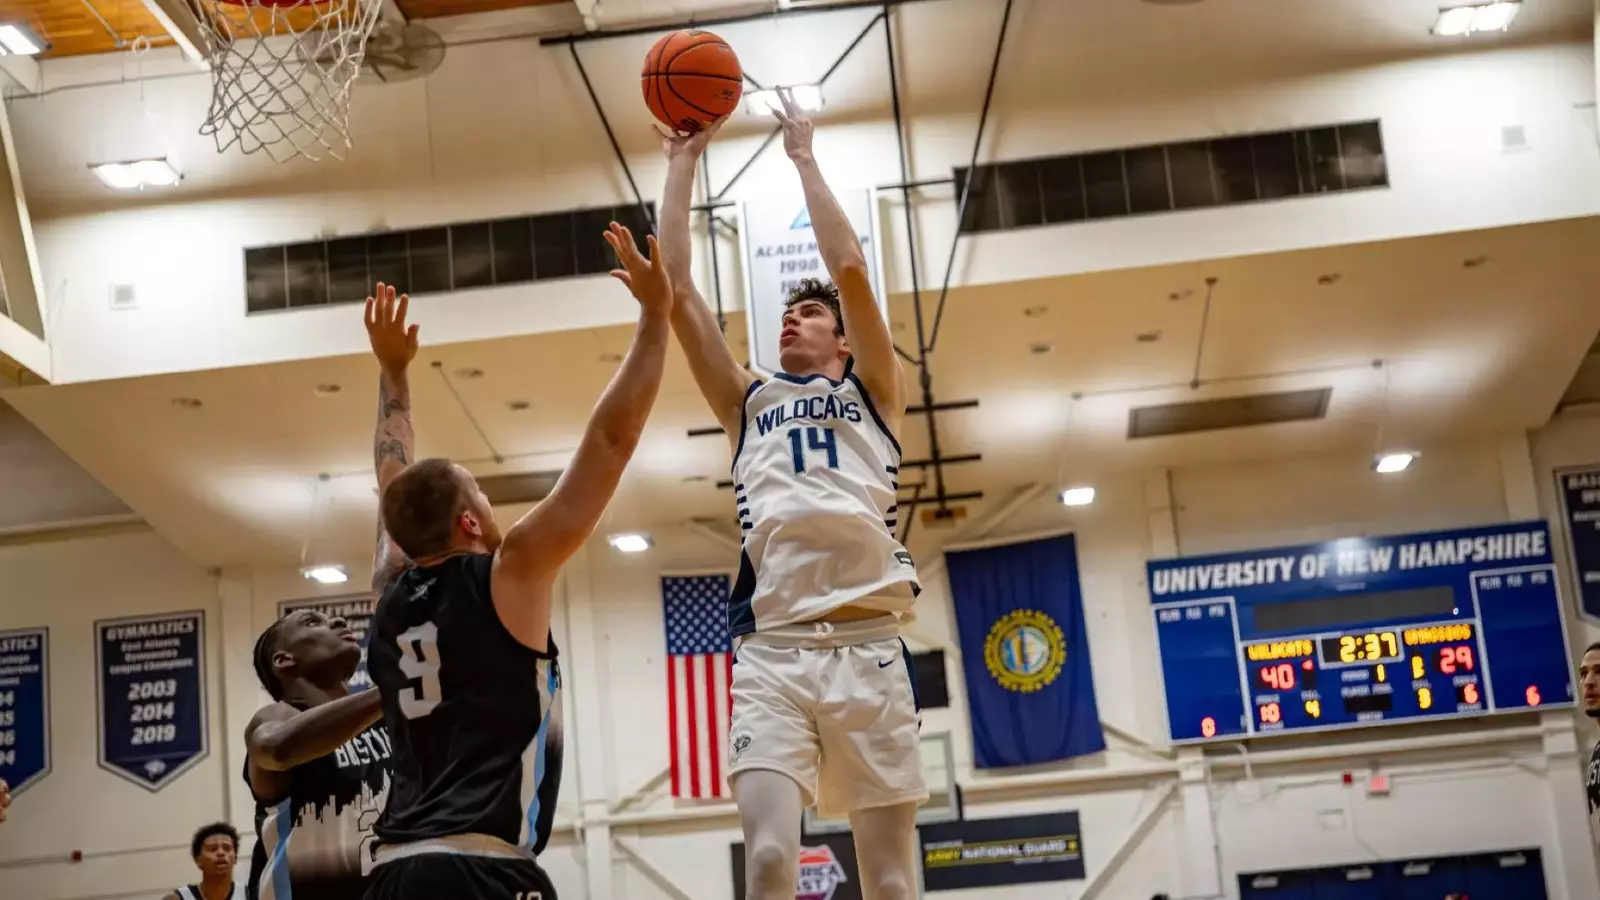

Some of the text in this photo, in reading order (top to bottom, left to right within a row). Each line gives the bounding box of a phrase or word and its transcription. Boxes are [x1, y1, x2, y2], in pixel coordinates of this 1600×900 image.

[755, 242, 818, 258] ACADEM
[755, 396, 862, 437] WILDCATS
[787, 427, 839, 476] 14
[1152, 530, 1547, 595] UNIVERSITY OF NEW HAMPSHIRE
[106, 620, 194, 641] GYMNASTICS
[1340, 632, 1397, 663] 2:37
[1440, 646, 1474, 674] 29
[397, 621, 442, 720] 9
[1260, 663, 1296, 690] 40
[1376, 664, 1386, 682] 1
[128, 679, 177, 701] 2003
[130, 701, 175, 723] 2014
[130, 724, 177, 746] 2019
